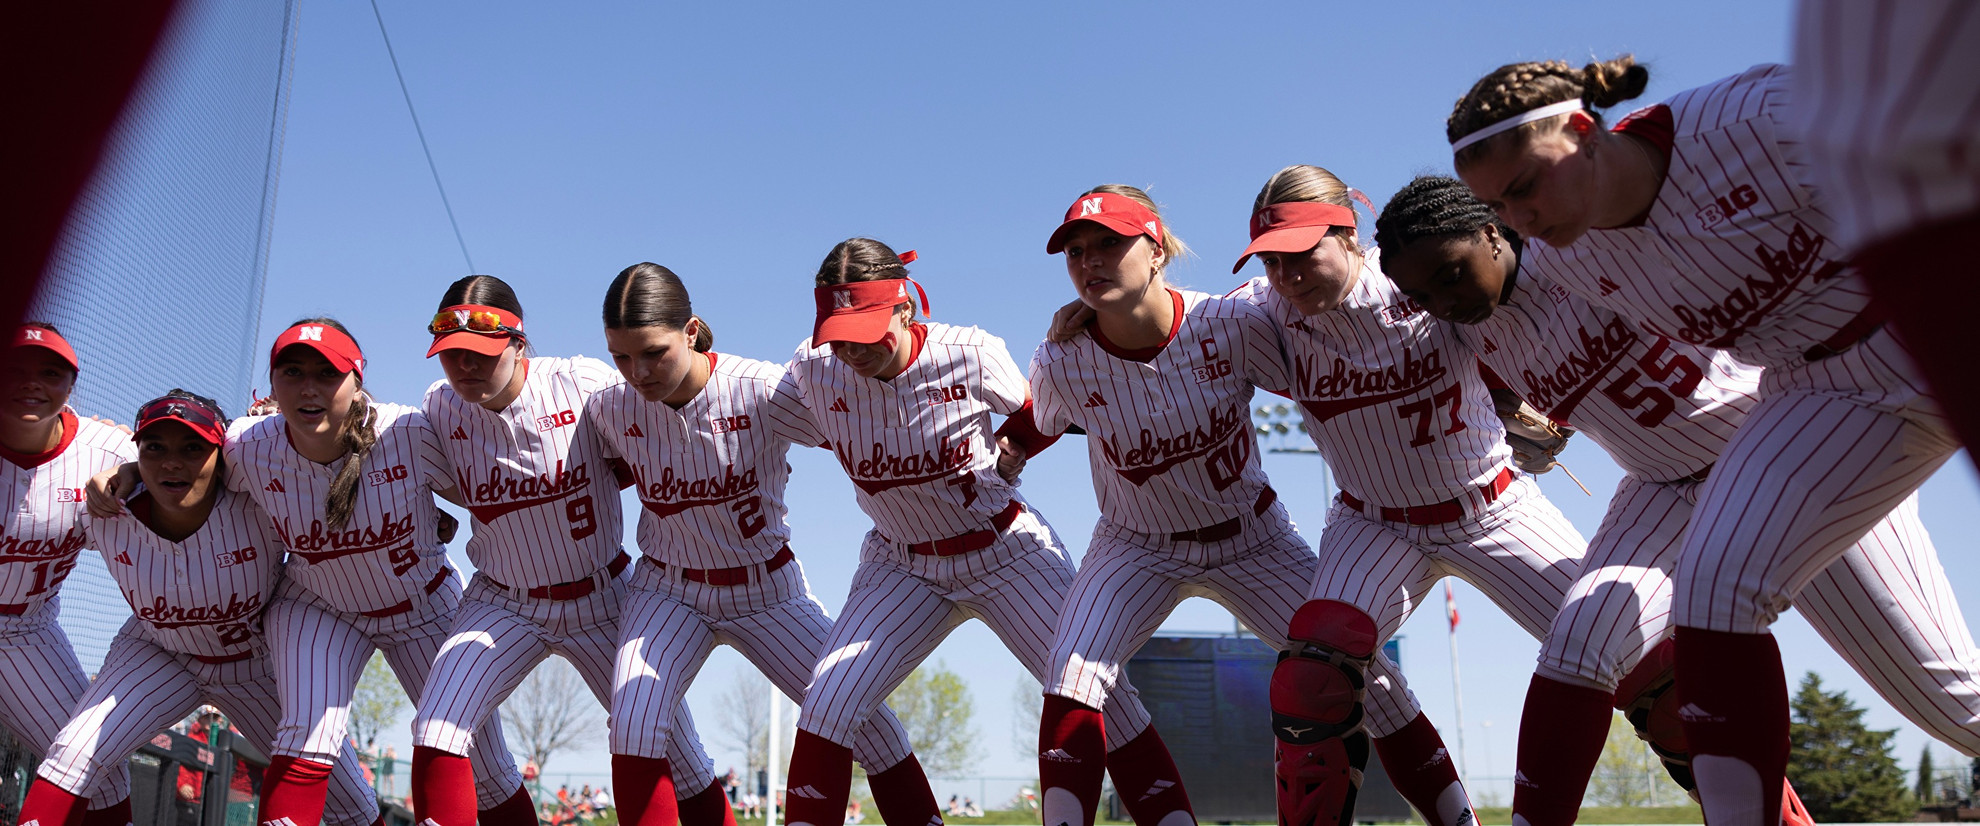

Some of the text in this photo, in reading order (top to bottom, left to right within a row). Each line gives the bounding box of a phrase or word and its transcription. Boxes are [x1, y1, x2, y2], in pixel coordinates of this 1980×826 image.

[1080, 197, 1103, 217] N
[1259, 210, 1271, 228] N
[832, 290, 853, 309] N
[25, 329, 43, 342] N
[299, 326, 323, 341] N
[1201, 338, 1218, 361] C
[1295, 347, 1447, 400] Nebraska
[1602, 335, 1704, 428] 55
[1396, 381, 1467, 448] 77
[1098, 403, 1240, 470] Nebraska
[836, 436, 972, 481] Nebraska
[457, 459, 591, 504] Nebraska
[632, 462, 760, 502] Nebraska
[272, 512, 416, 552] Nebraska
[565, 494, 597, 541] 9
[732, 495, 767, 539] 2
[388, 539, 420, 577] 5
